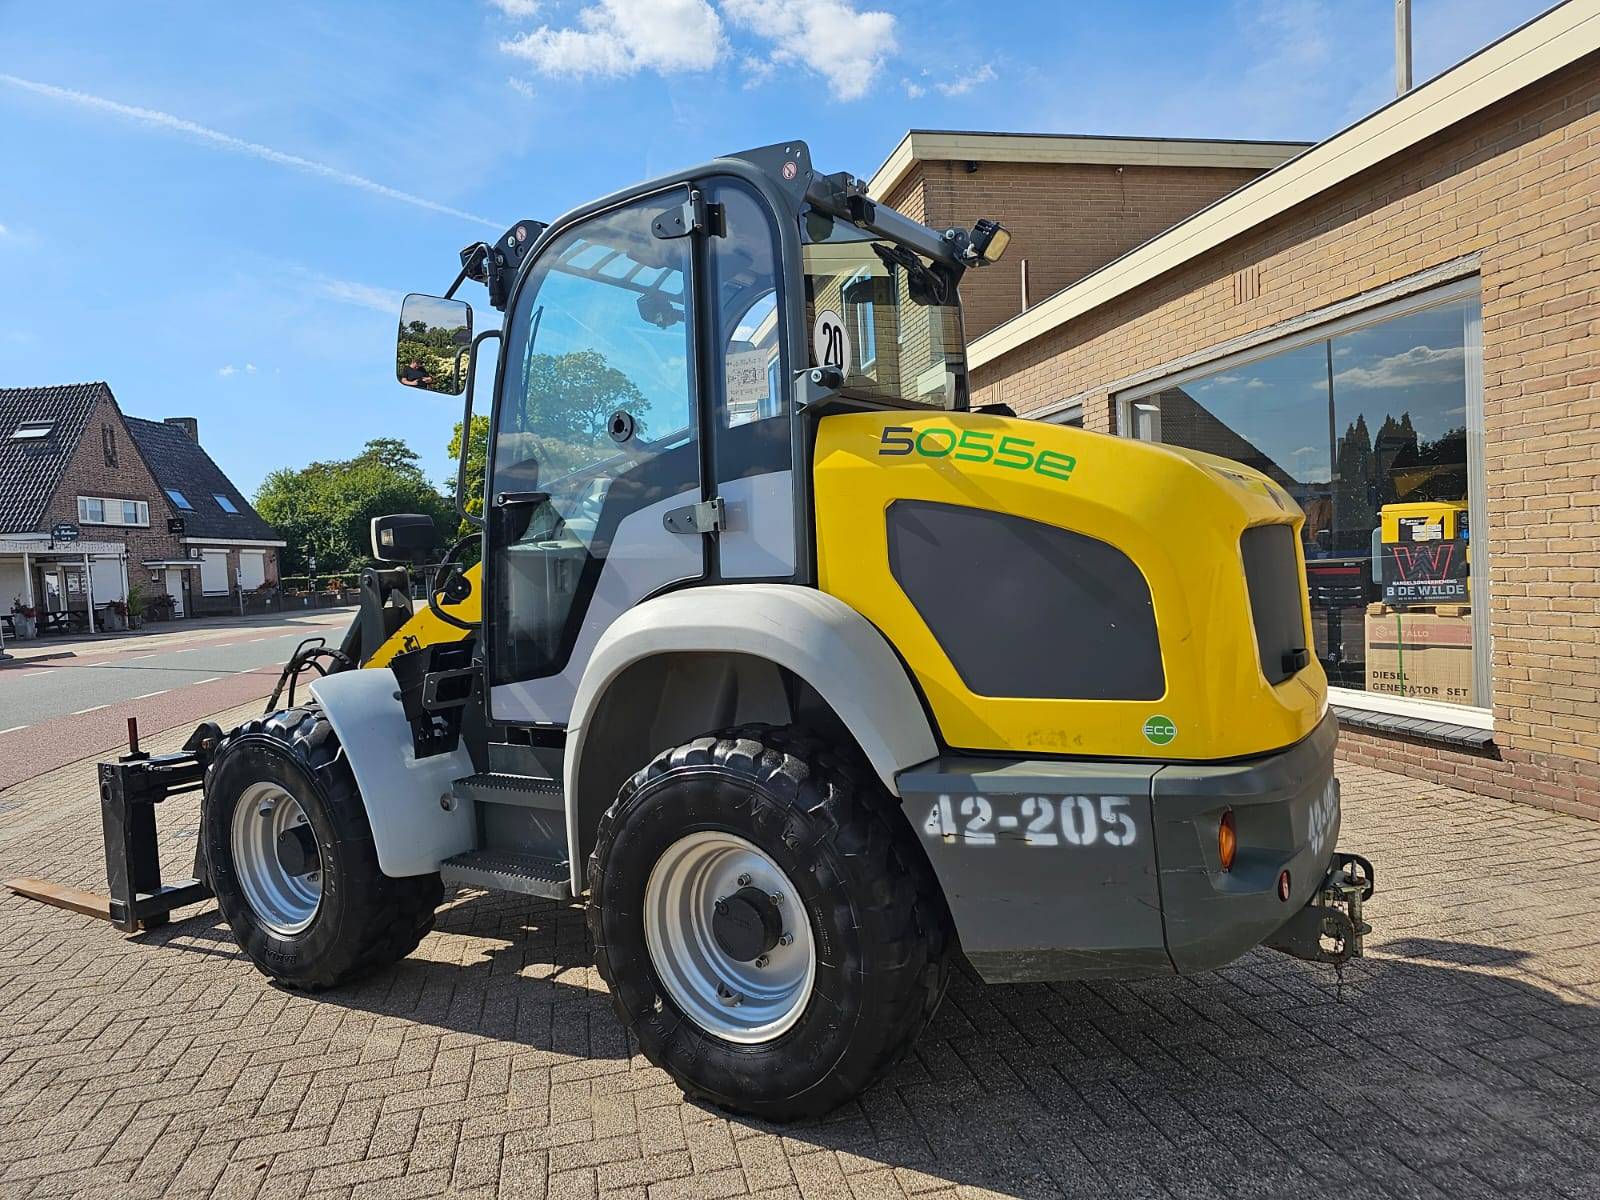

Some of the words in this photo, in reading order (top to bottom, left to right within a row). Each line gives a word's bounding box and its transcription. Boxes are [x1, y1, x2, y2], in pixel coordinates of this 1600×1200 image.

[822, 322, 844, 369] 20
[878, 426, 1077, 481] 5055e
[1386, 587, 1394, 596] B
[1398, 586, 1415, 595] DE
[1418, 585, 1464, 595] WILDE
[1372, 671, 1409, 681] DIESEL
[1372, 683, 1439, 694] GENERATOR
[1446, 687, 1469, 697] SET
[1144, 725, 1175, 736] ECO
[923, 794, 1137, 846] 42-205
